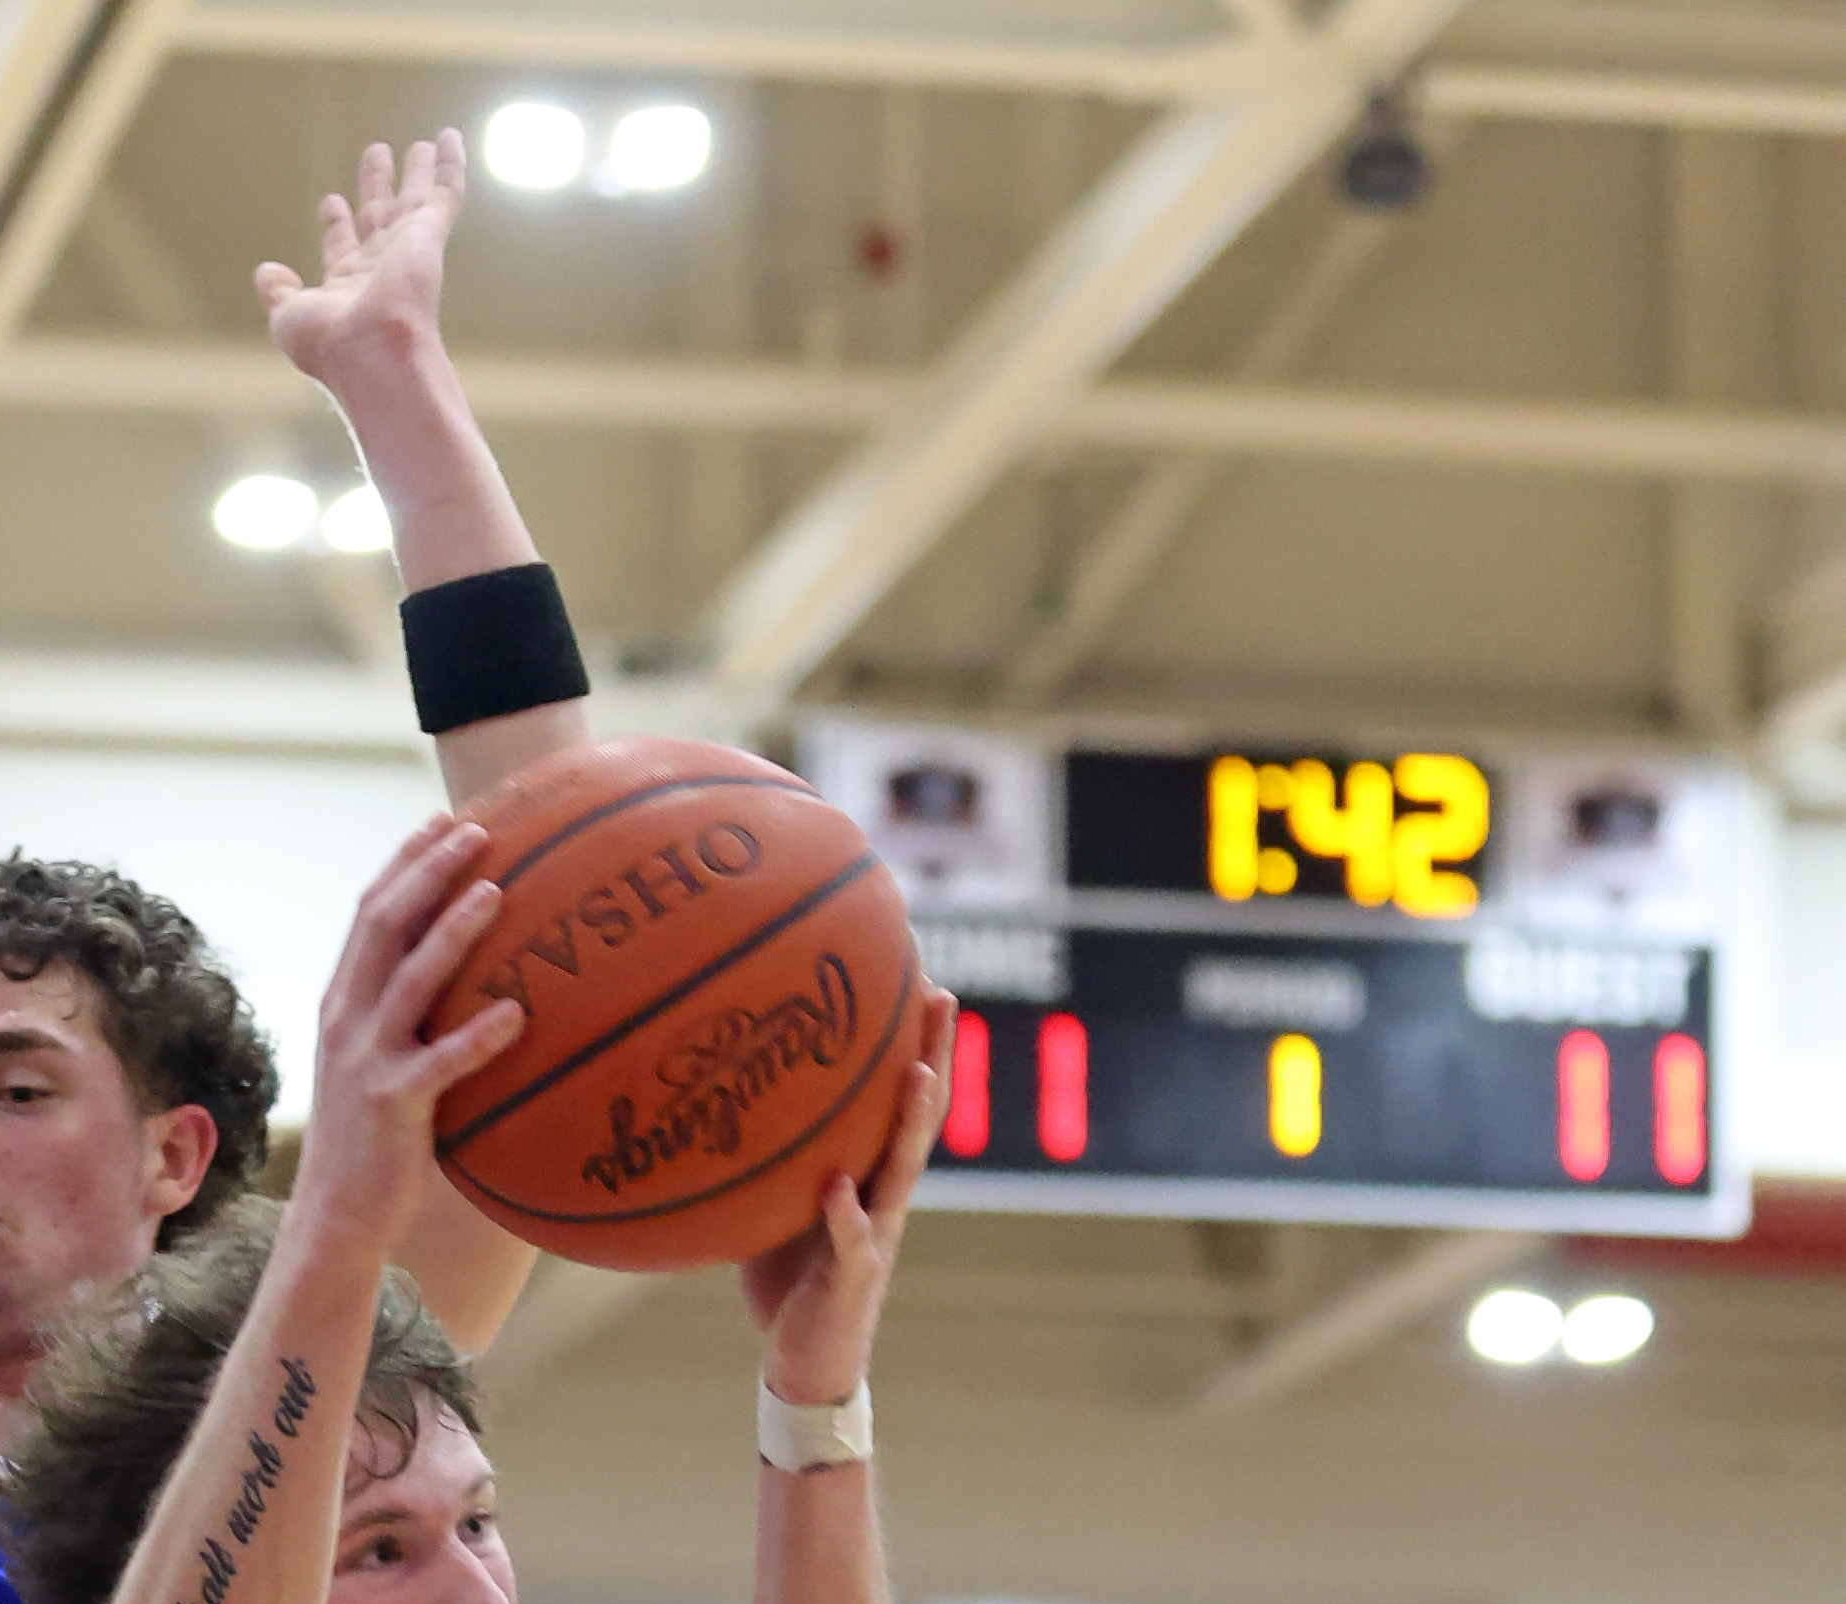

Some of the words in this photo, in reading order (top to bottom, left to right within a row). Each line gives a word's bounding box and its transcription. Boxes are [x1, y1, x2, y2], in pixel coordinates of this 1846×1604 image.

[479, 820, 762, 1017] OHSAA
[1207, 753, 1489, 919] 1:42
[581, 952, 857, 1193] Rawlings
[1268, 1030, 1322, 1158] 1
[1557, 1028, 1707, 1187] 11
